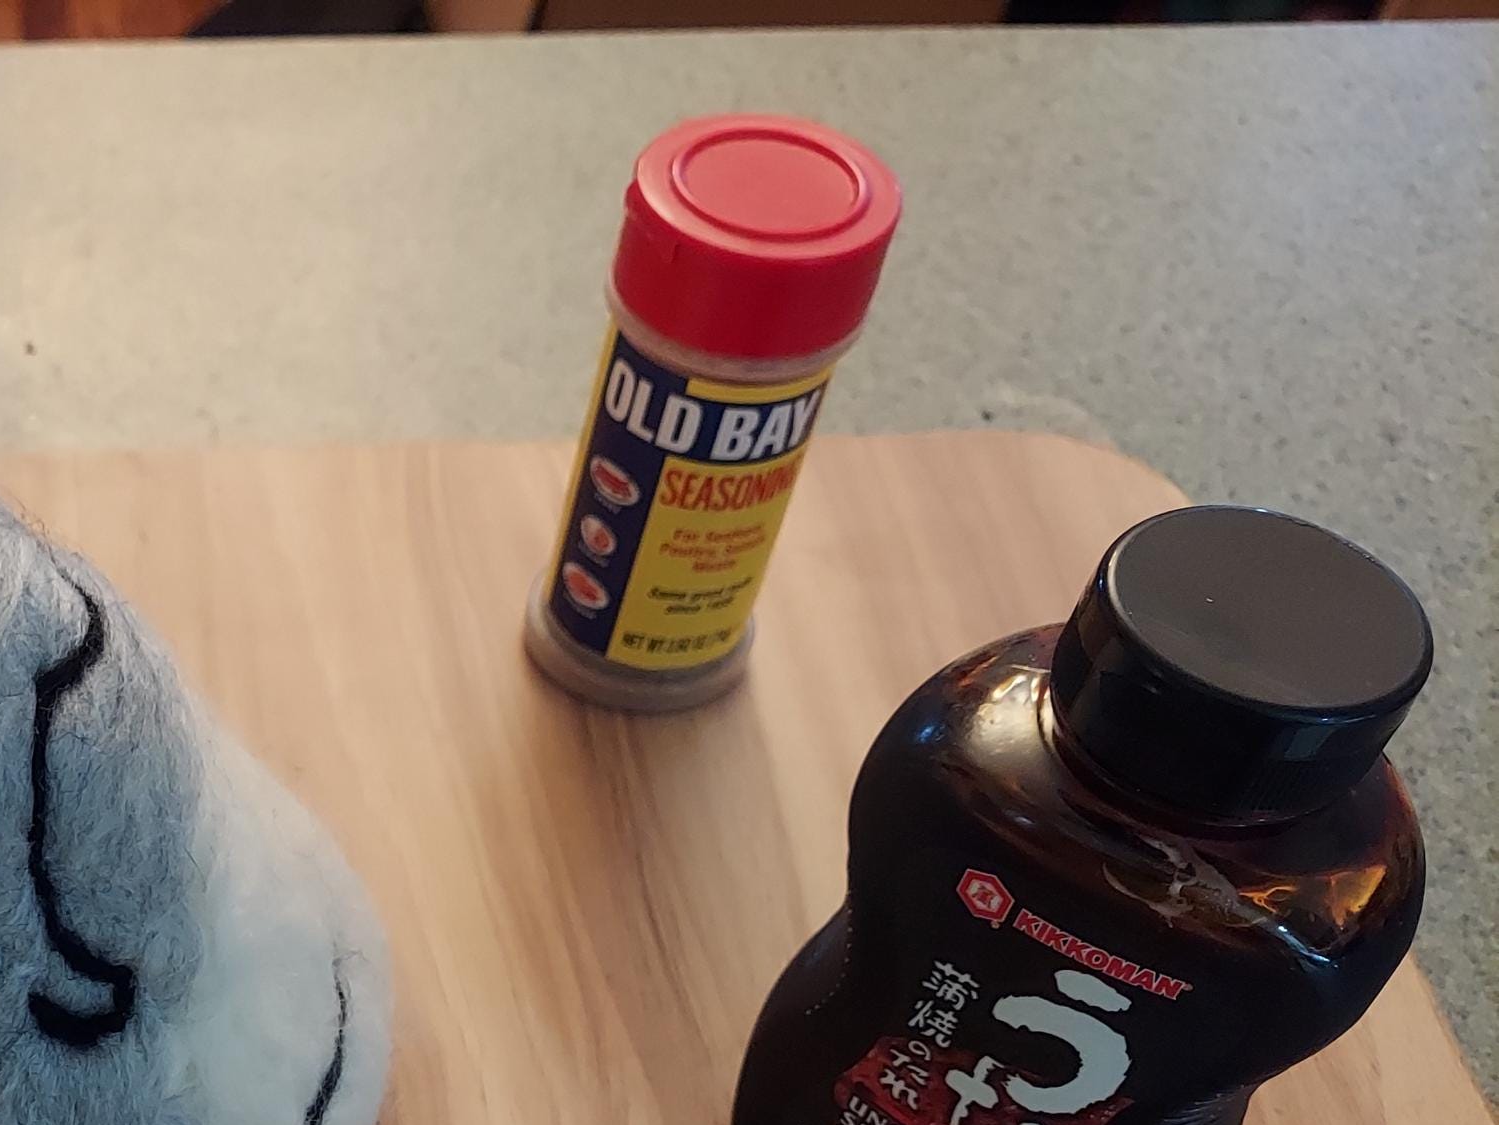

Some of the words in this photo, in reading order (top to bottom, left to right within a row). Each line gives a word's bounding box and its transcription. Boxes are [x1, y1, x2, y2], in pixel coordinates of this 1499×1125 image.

[605, 359, 703, 454] OLD
[709, 388, 822, 461] BAY
[1012, 908, 1185, 1000] KIKKOMAN
[880, 960, 980, 1110] 蒲焼のたれ
